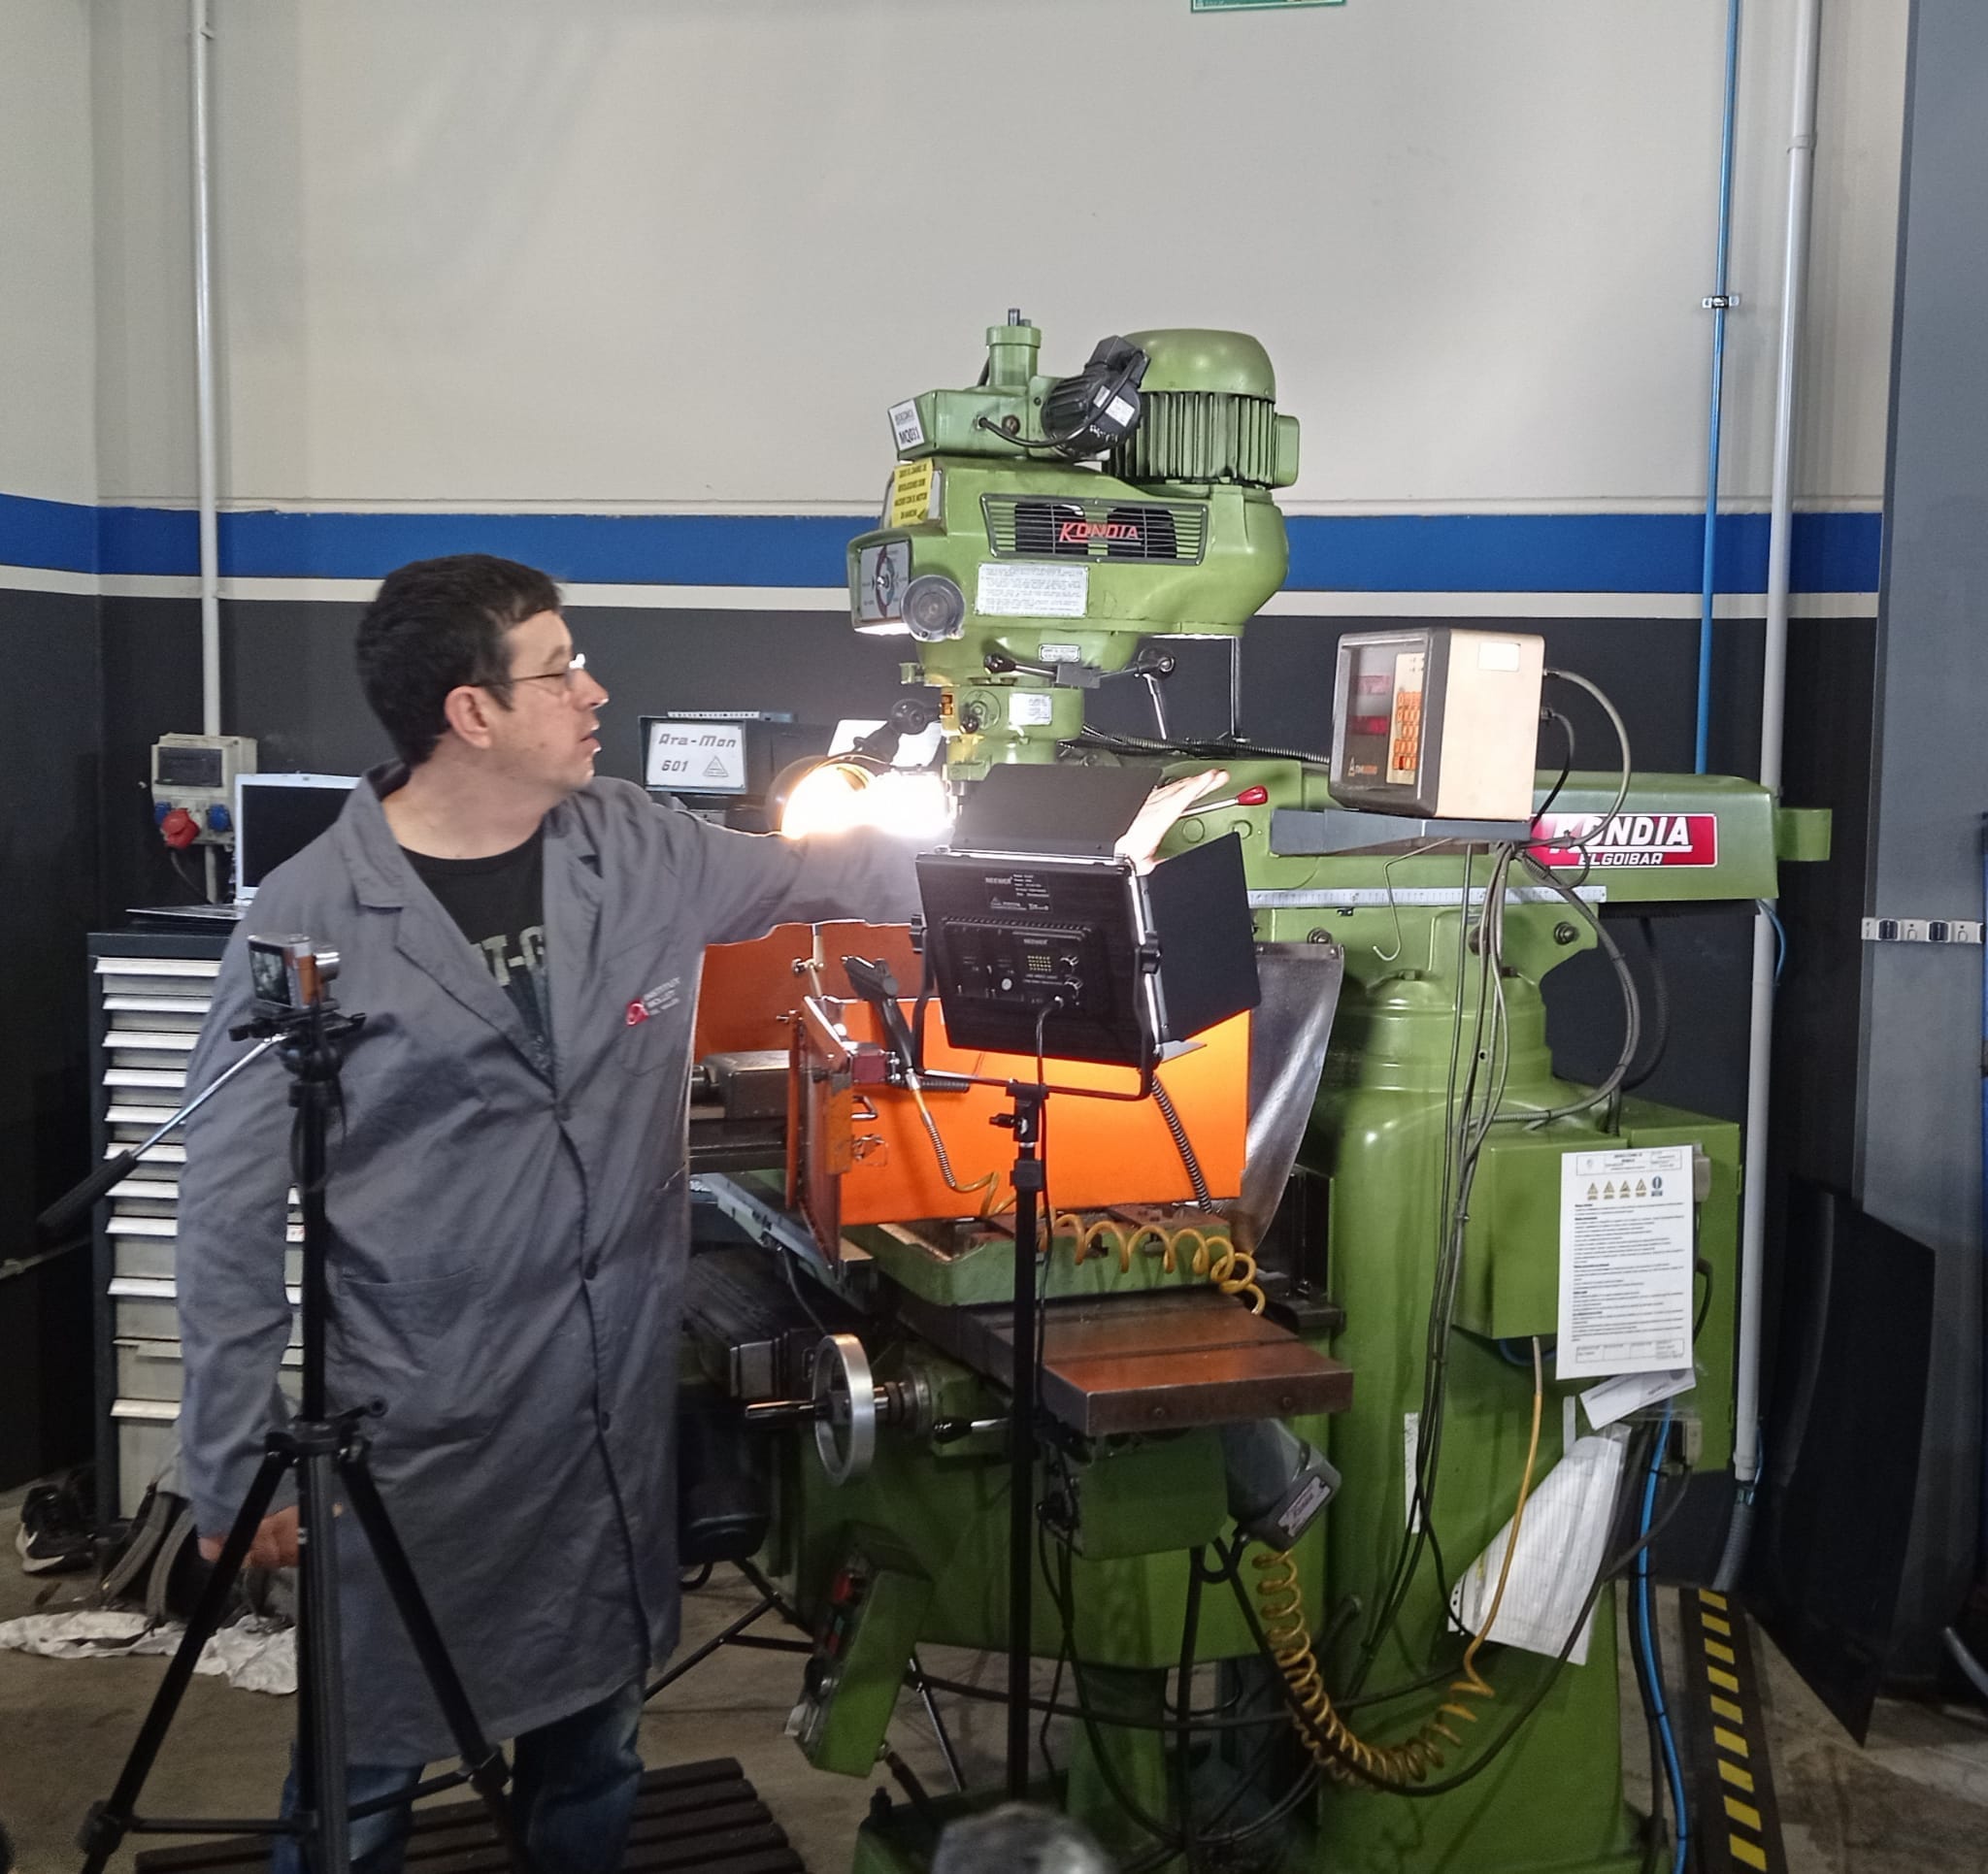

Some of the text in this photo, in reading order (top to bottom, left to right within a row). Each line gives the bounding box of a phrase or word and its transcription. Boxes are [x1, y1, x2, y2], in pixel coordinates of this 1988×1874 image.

[1059, 522, 1140, 543] KONDIA
[661, 760, 688, 773] 601
[1578, 853, 1663, 866] ELGOIBAR
